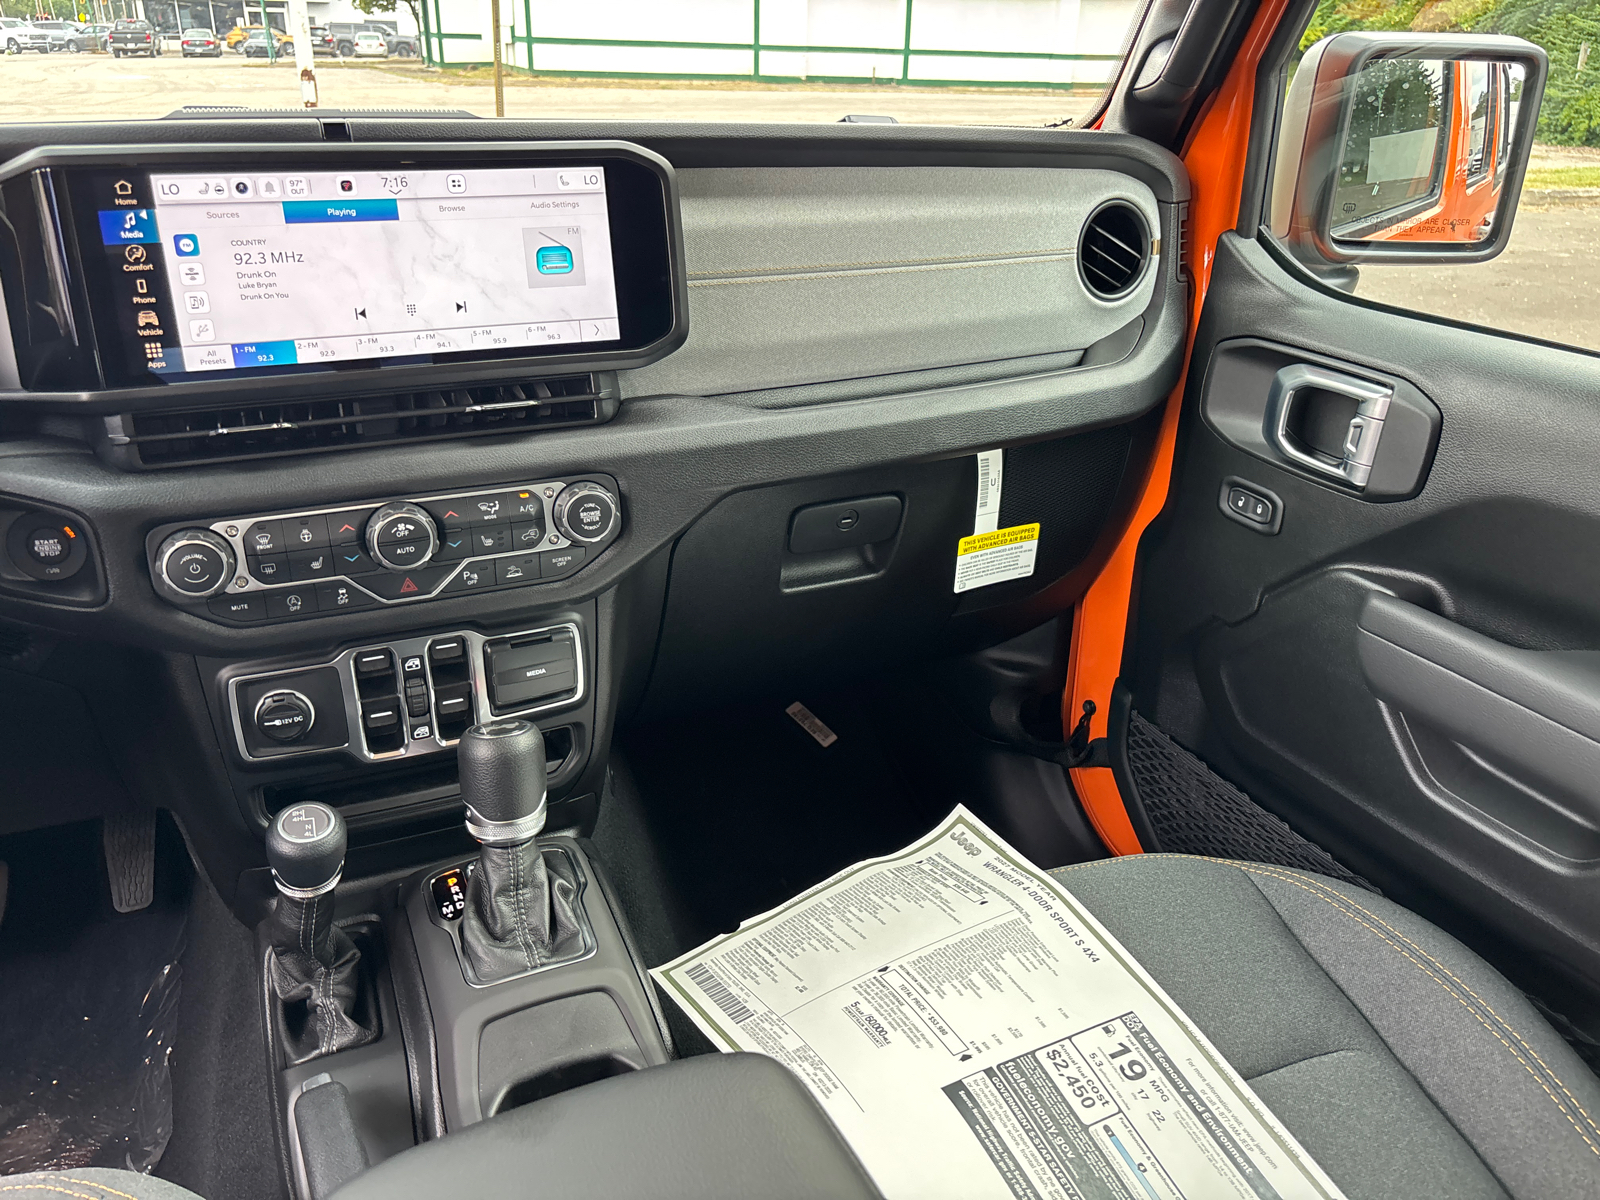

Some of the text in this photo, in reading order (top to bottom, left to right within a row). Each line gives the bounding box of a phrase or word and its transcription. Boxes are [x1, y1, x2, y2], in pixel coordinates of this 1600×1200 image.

[380, 177, 408, 188] 7:16
[584, 175, 598, 185] LO
[161, 184, 180, 195] LO
[327, 208, 356, 216] Playing
[234, 252, 304, 265] 92.3 MHz
[258, 281, 277, 289] Bryan
[200, 357, 226, 366] Presets
[976, 534, 999, 543] VEHICLE
[1007, 526, 1035, 537] EQUIPPED
[977, 538, 1007, 549] ADVANCED
[526, 668, 546, 676] MEDIA
[950, 832, 982, 856] Jeep
[1009, 866, 1035, 884] MODEL
[1034, 883, 1058, 901] YEAR
[454, 893, 463, 901] N
[442, 905, 454, 914] M
[982, 860, 1101, 964] WRANGLER 4-DOOR SPORT S 4X4
[897, 983, 914, 998] TOTAL
[910, 996, 929, 1013] PRICE:
[1120, 1015, 1138, 1032] DOT
[1126, 1012, 1144, 1028] EPA
[863, 1027, 884, 1047] WARRANTY
[1088, 1052, 1104, 1068] 5.3
[1108, 1042, 1150, 1081] 19
[1124, 1035, 1156, 1071] Fuel Economy
[1046, 1049, 1096, 1108] $2,450
[1058, 1043, 1110, 1107] Annual fuel cost
[971, 1087, 988, 1109] rollover
[1135, 1088, 1149, 1100] 17
[1147, 1079, 1170, 1102] MPG
[1004, 1060, 1075, 1158] fueleconomy.gov
[1138, 1032, 1255, 1174] Fuel Economy and Environment
[1204, 1095, 1217, 1106] call
[1150, 1108, 1166, 1123] 22
[1184, 1057, 1196, 1067] For
[1192, 1067, 1207, 1082] more
[1204, 1082, 1233, 1114] information
[1240, 1127, 1279, 1170] www.jeep.com
[972, 1078, 980, 1087] for
[977, 1086, 994, 1107] overall
[991, 1107, 1008, 1129] vehicle
[1019, 1148, 1036, 1169] frontal
[978, 1076, 1056, 1187] This vehicle has not been rated by the
[957, 1089, 1028, 1189] Source: National Highway Traffic Safety
[990, 1076, 1074, 1194] GOVERNMENT 5-STAR SAFETY
